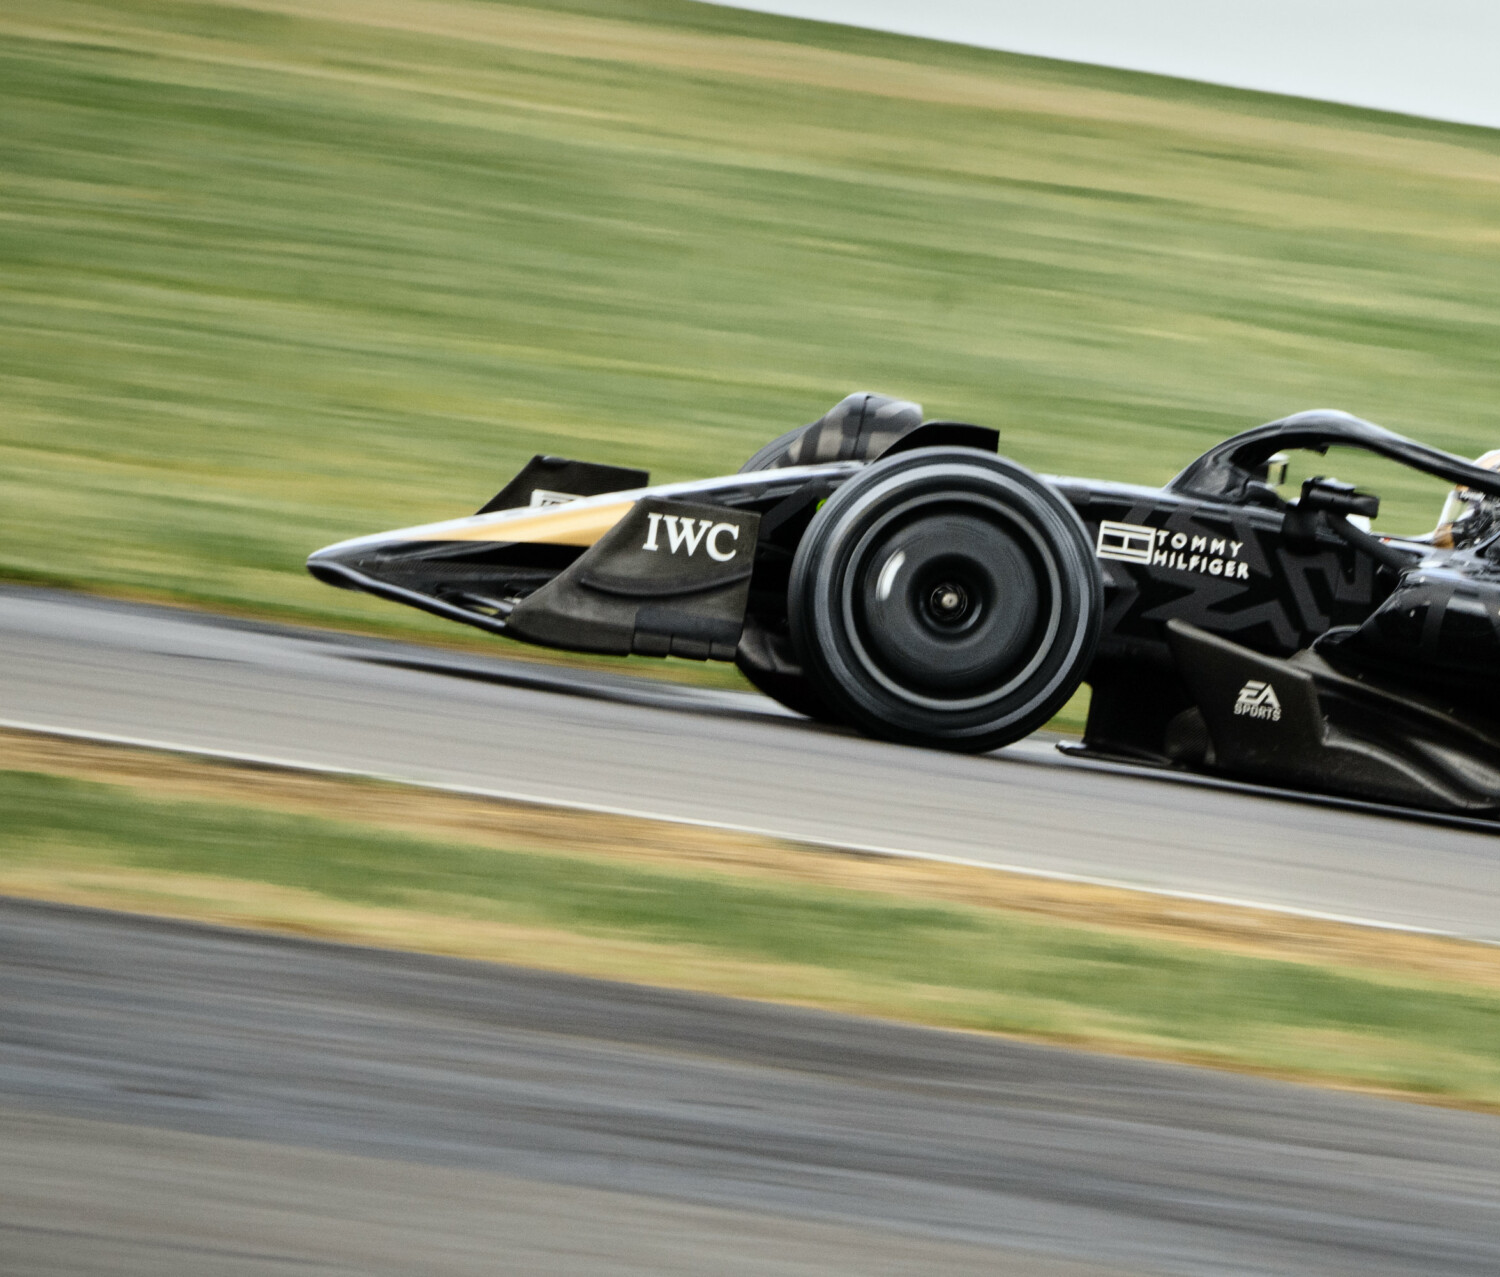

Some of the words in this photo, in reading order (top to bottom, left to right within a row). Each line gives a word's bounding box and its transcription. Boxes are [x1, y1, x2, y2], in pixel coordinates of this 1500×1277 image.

[642, 511, 740, 562] IWC
[1156, 530, 1243, 557] TOMMY
[1153, 550, 1249, 579] HILFIGER
[1238, 680, 1280, 708] EA
[1234, 702, 1281, 721] SPORTS
